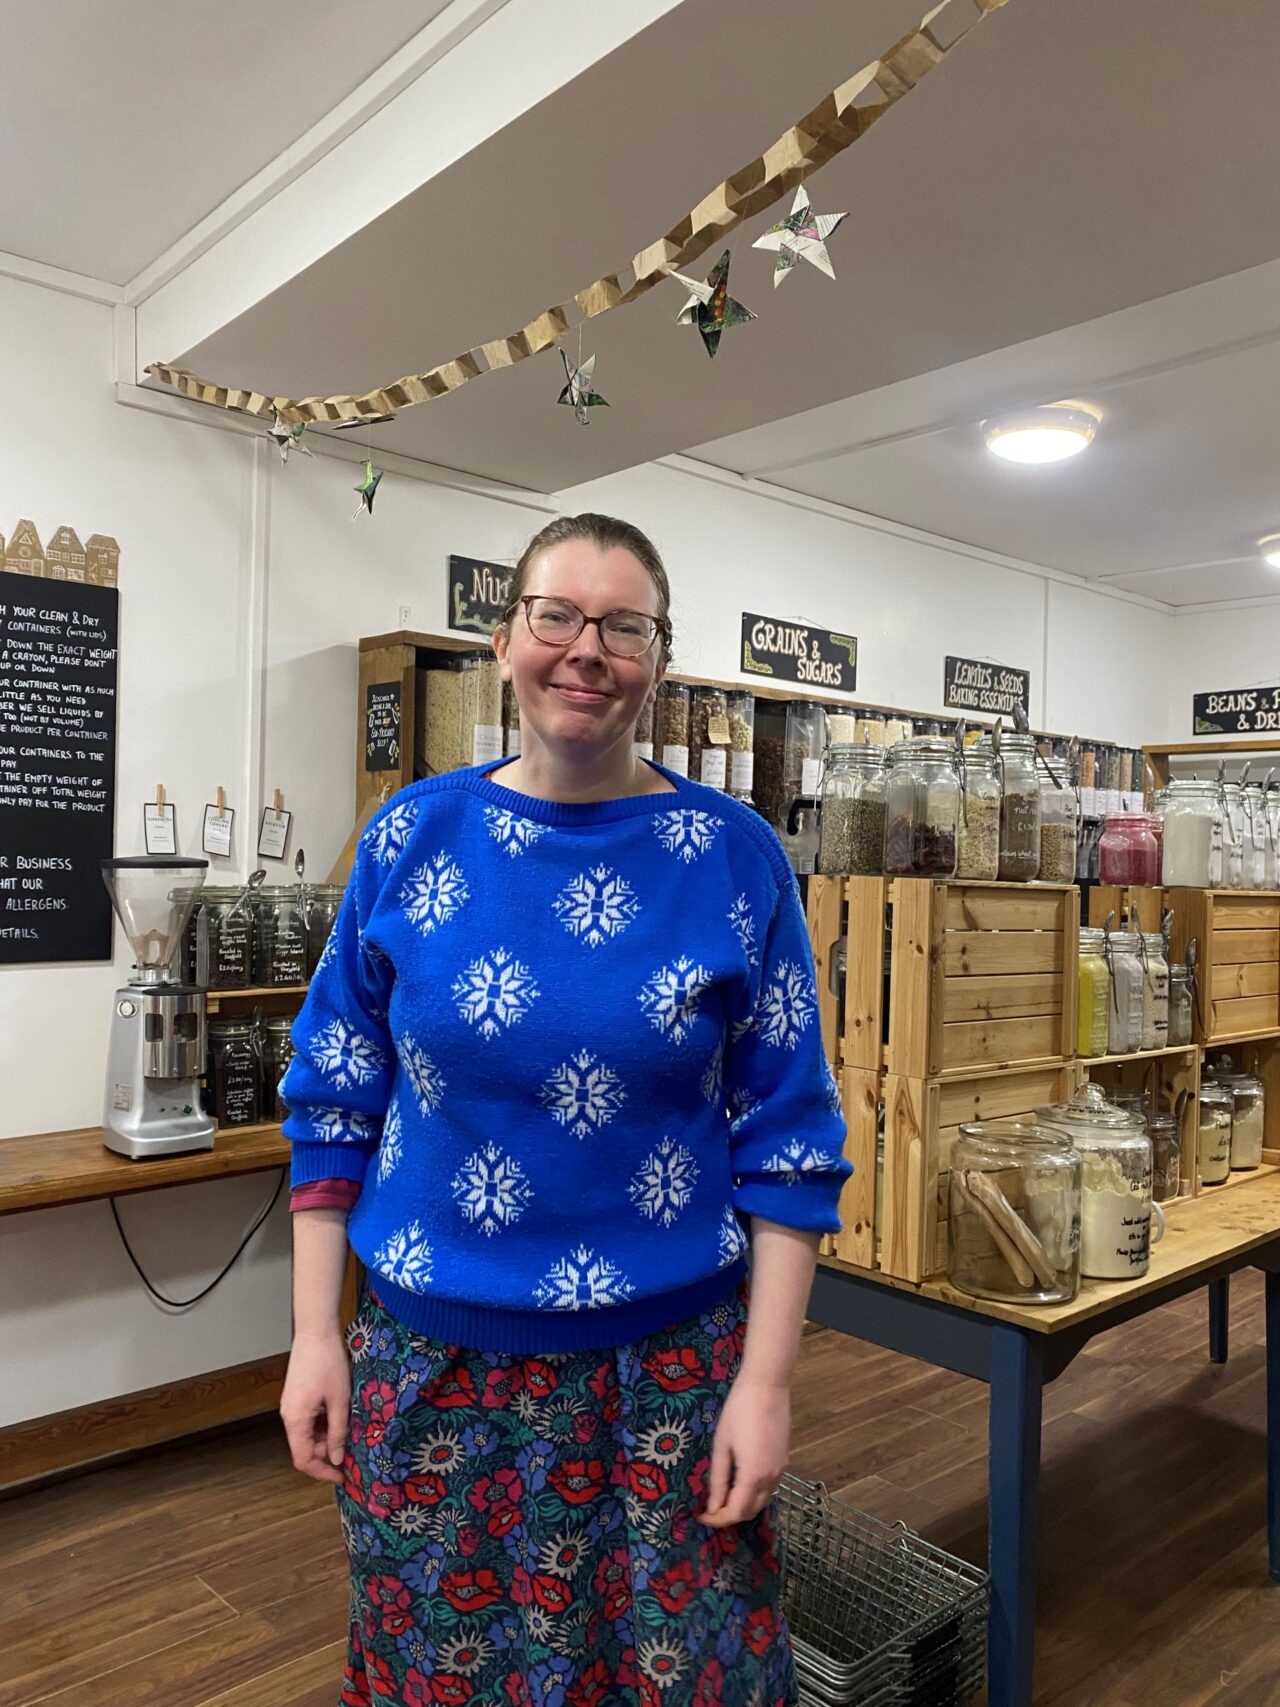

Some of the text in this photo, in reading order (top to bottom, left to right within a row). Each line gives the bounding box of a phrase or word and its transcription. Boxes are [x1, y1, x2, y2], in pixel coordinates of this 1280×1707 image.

[13, 605, 36, 617] YOUR
[39, 609, 68, 622] CLEAN
[72, 611, 80, 625] &
[82, 614, 99, 626] DRY
[7, 621, 62, 634] CONTAINERS
[752, 619, 821, 660] GRAINS &
[6, 638, 118, 660] DOWN THE EXACT WEIGHT
[2, 650, 8, 660] A
[12, 651, 48, 665] CRAYON,
[50, 654, 81, 666] PLEASE
[14, 664, 26, 672] OR
[31, 663, 55, 674] DOWN
[797, 656, 842, 686] SUGARS
[954, 661, 1024, 695] LENTILS & SEEDS
[13, 678, 59, 692] CONTAINER
[61, 683, 82, 693] WITH
[84, 686, 95, 694] AS
[96, 687, 114, 697] MUCH
[949, 684, 978, 707] BAKING
[30, 692, 42, 702] AS
[46, 694, 60, 703] YOU
[65, 696, 86, 706] NEED
[1206, 691, 1258, 714] BEANS
[1261, 697, 1270, 710] &
[3, 712, 17, 721] TOO
[20, 712, 38, 724] (NOT
[40, 716, 50, 724] BY
[19, 703, 33, 712] WE
[37, 704, 56, 714] SELL
[59, 707, 91, 718] LIQUIDS
[94, 710, 104, 718] BY
[1237, 713, 1250, 730] &
[10, 724, 44, 734] PRODUCT
[46, 727, 62, 737] PER
[64, 729, 108, 740] CONTAINER
[19, 747, 72, 760] CONTAINERS
[75, 750, 86, 760] TO
[88, 752, 104, 762] THE
[1, 759, 16, 768] PAY
[4, 771, 102, 786] THE EMPTY WEIGHT OF
[31, 786, 48, 795] OFF
[50, 786, 75, 797] TOTAL
[77, 789, 107, 799] WEIGHT
[18, 797, 32, 807] PAY
[35, 799, 50, 808] FOR
[51, 800, 68, 810] THE
[72, 802, 106, 813] PRODUCT
[16, 855, 72, 871] BUSINESS
[22, 877, 44, 890] OUR
